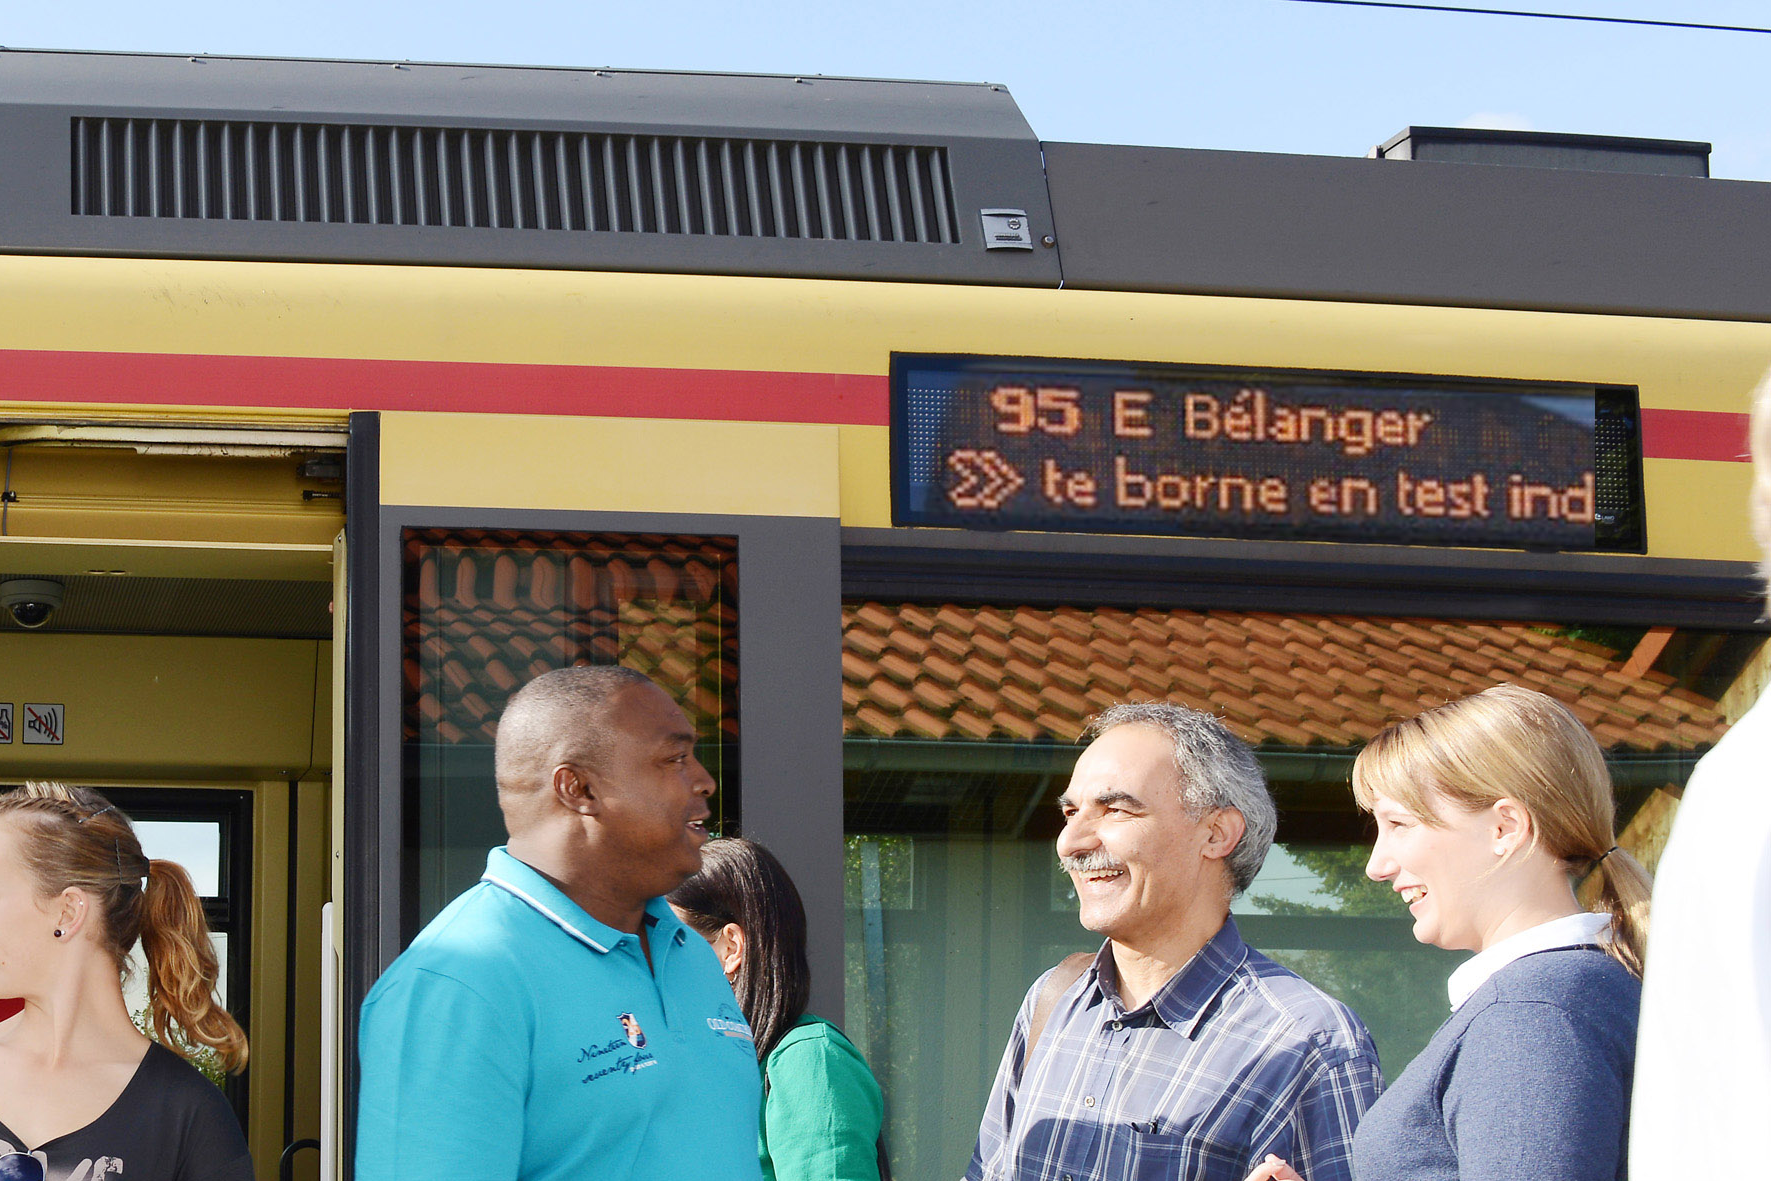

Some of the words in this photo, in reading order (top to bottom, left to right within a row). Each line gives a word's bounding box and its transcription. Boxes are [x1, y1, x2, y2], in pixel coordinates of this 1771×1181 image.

[991, 386, 1081, 434] 95
[1113, 390, 1153, 437] E
[1185, 389, 1433, 453] Bélanger
[1042, 457, 1096, 507] te
[1115, 457, 1287, 515] borne
[1309, 477, 1376, 517] en
[1396, 471, 1490, 519] test
[1507, 471, 1595, 523] ind
